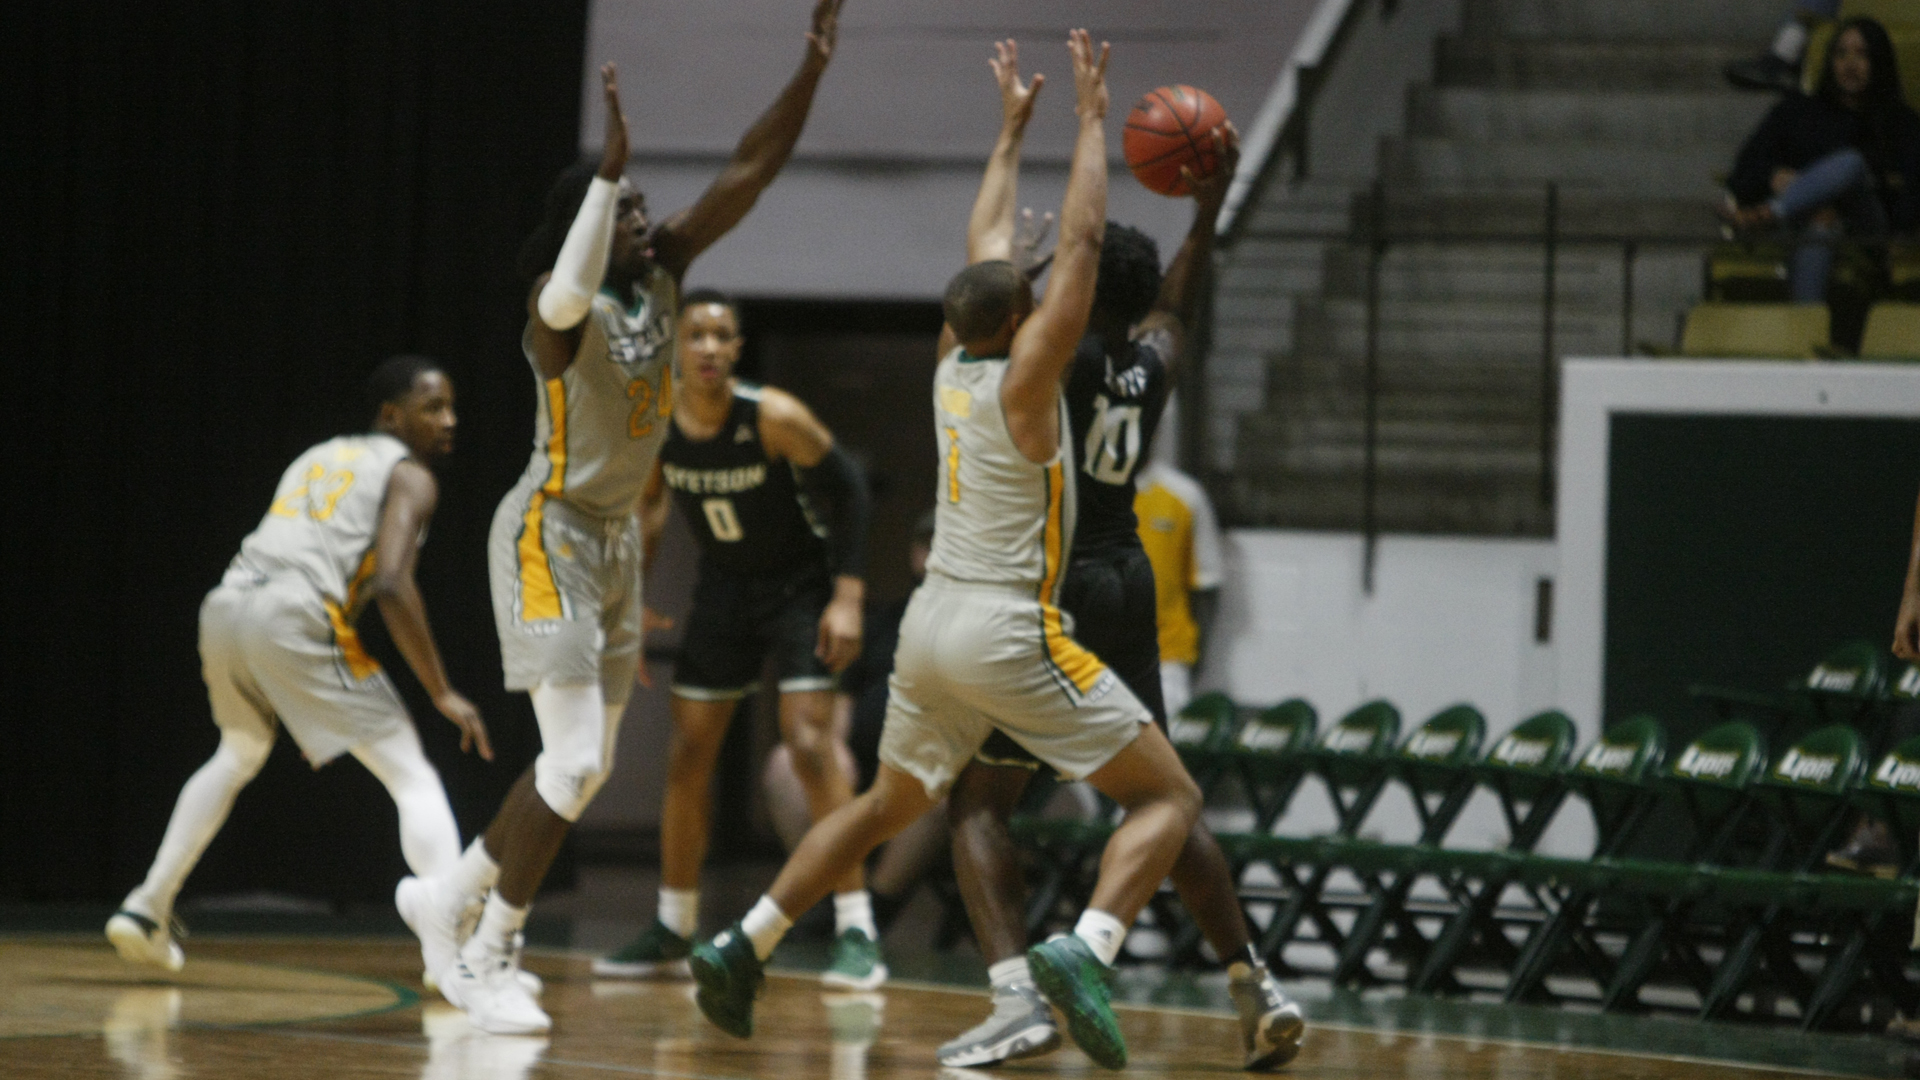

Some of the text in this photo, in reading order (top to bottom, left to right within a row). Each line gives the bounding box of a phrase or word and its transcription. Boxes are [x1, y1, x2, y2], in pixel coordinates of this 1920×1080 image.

[627, 363, 673, 438] 24
[944, 425, 960, 503] 1
[1083, 394, 1142, 485] 10
[270, 463, 354, 522] 23
[661, 463, 767, 494] STETSON
[702, 498, 744, 542] 0
